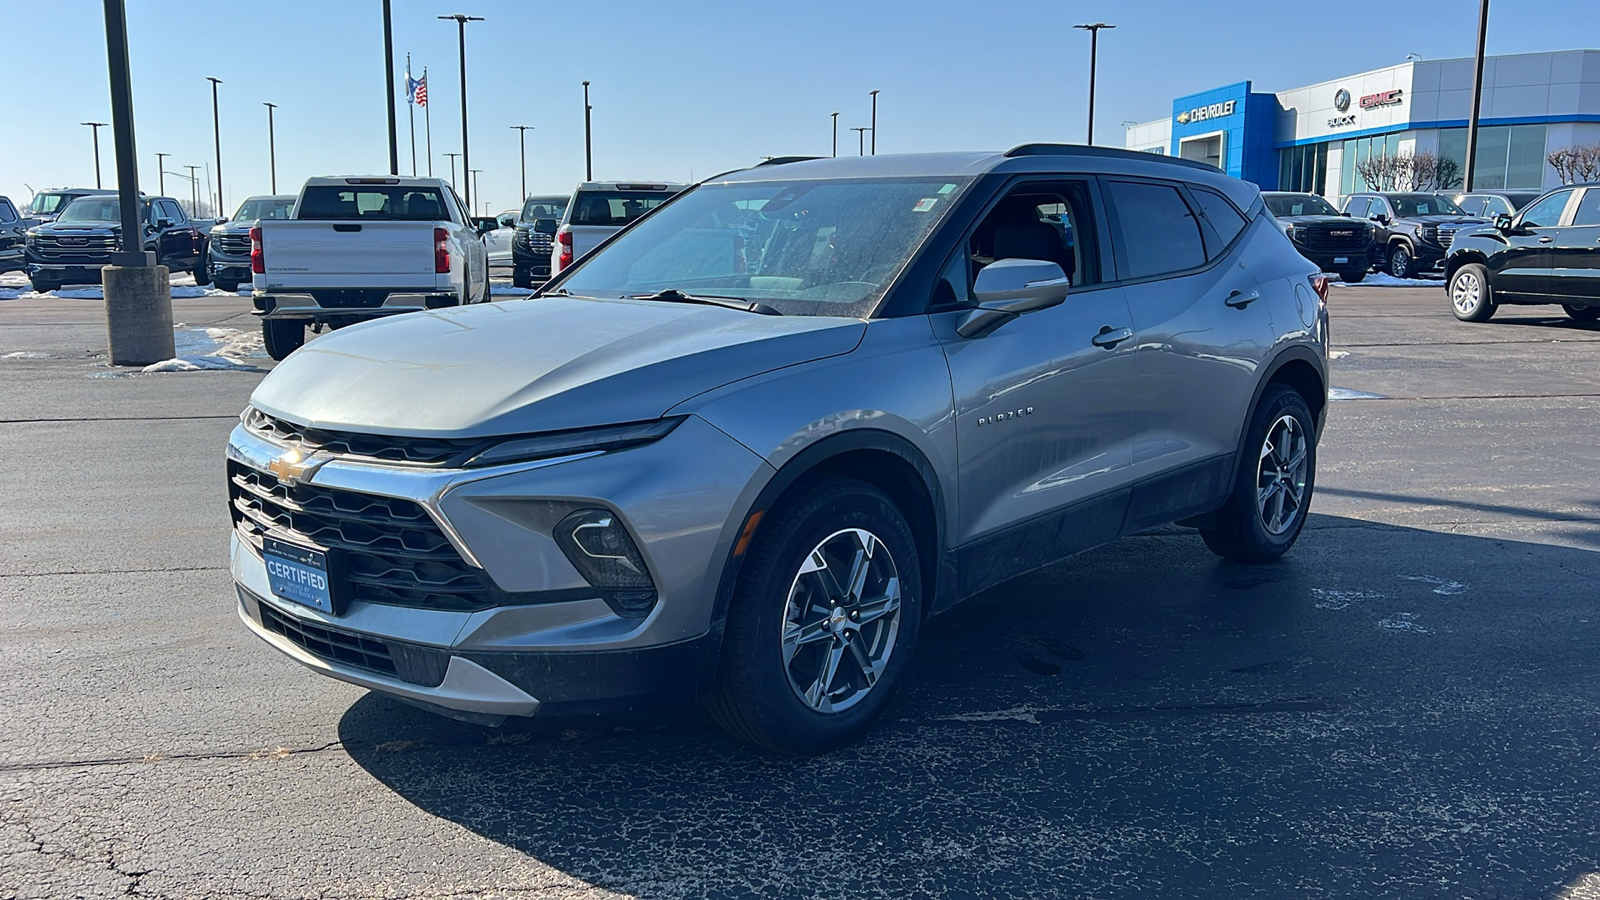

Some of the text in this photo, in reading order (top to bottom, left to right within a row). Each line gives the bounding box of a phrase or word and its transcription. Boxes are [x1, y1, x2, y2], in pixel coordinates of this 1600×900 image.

[1360, 89, 1402, 110] GMC
[1191, 100, 1236, 122] CHEVROLET
[1328, 115, 1356, 127] BUICK
[978, 406, 1034, 427] BLAZER
[268, 560, 326, 591] CERTIFIED
